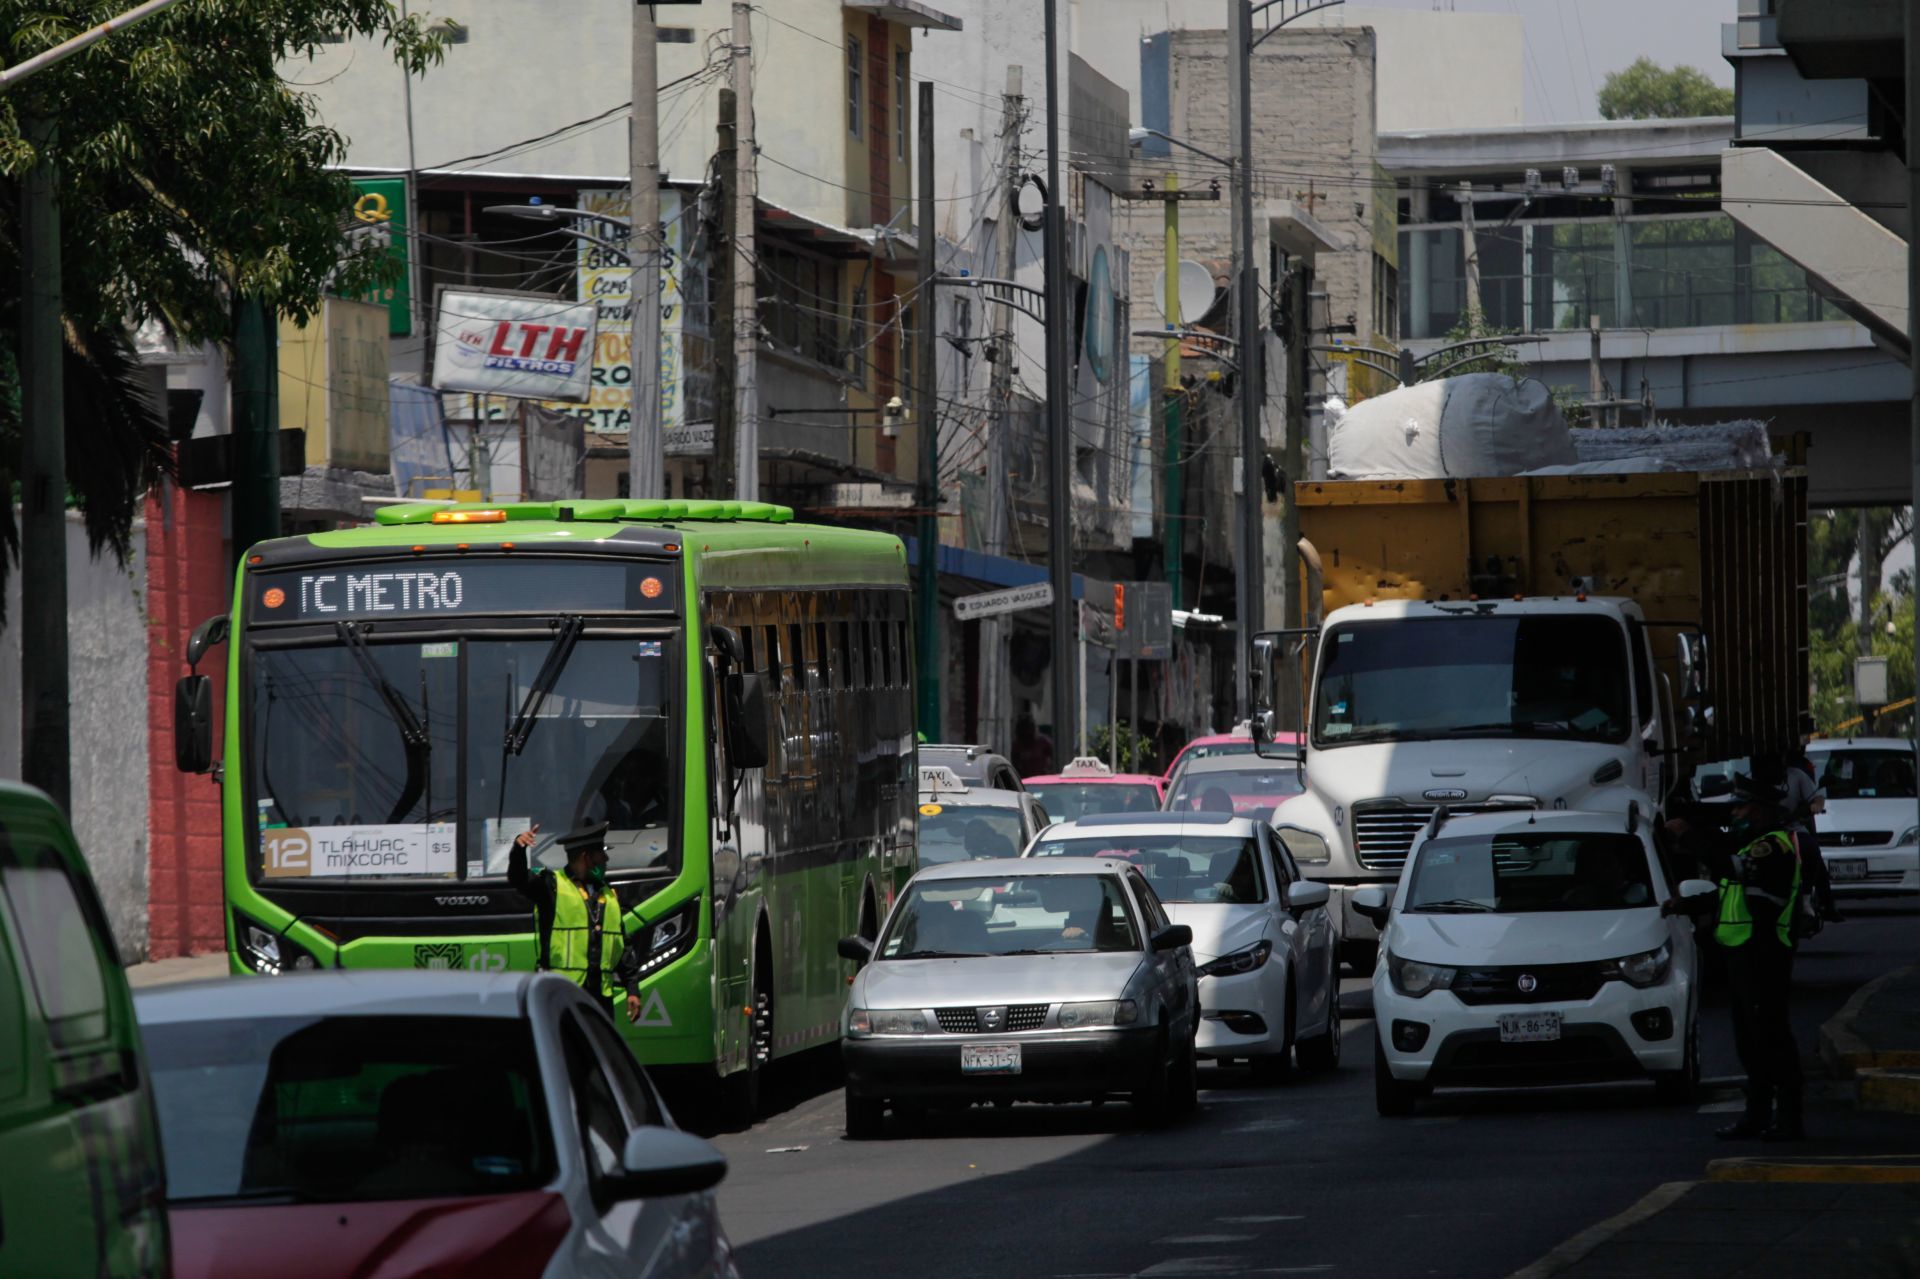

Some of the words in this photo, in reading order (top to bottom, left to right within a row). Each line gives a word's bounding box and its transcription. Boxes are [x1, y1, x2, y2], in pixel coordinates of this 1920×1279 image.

[489, 320, 587, 362] LTH
[347, 572, 463, 611] METRO
[1075, 760, 1097, 768] TAXI
[922, 771, 945, 780] TAXI
[319, 837, 405, 853] TLÁHUAC
[432, 842, 451, 853] $5
[268, 838, 308, 868] 12
[327, 852, 408, 867] MIXCOAC
[434, 895, 489, 906] VOLVO
